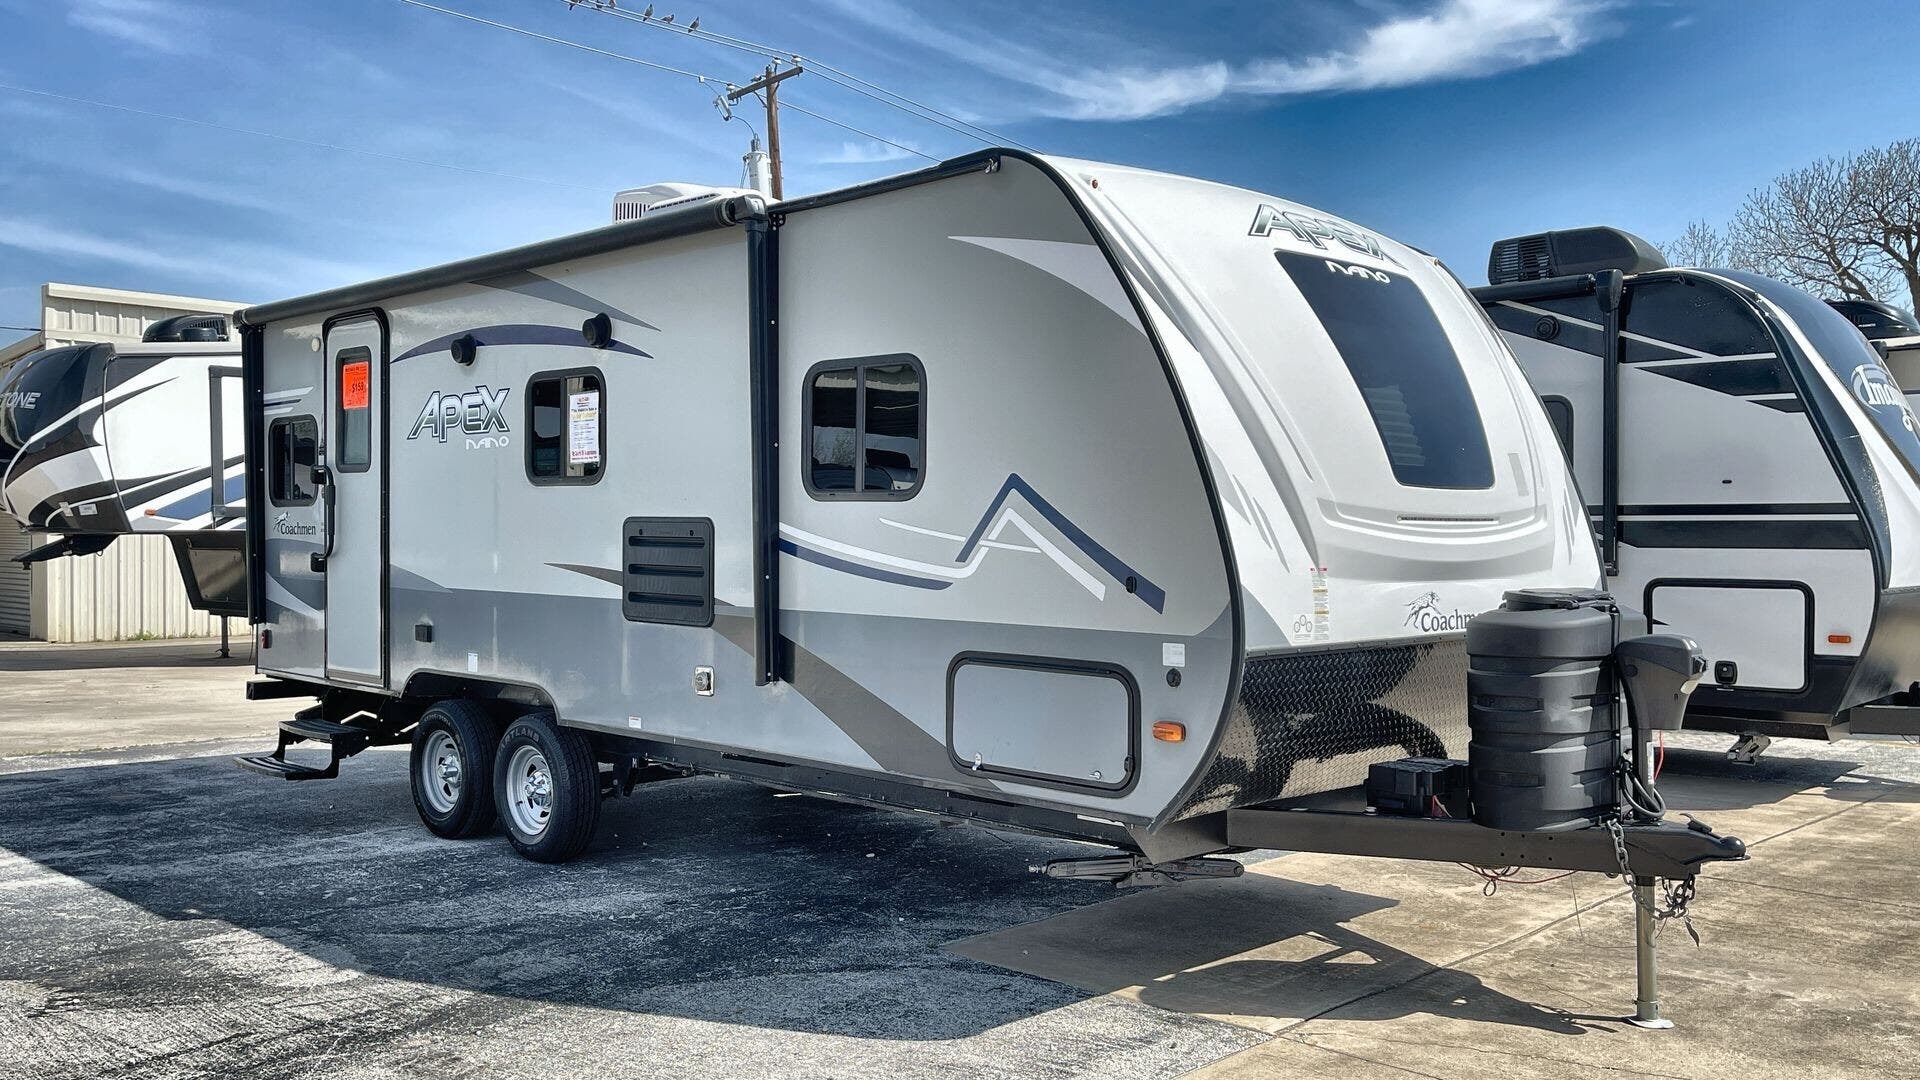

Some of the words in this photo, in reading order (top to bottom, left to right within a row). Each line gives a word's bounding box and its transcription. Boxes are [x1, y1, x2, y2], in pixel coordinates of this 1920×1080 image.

[1248, 203, 1409, 271] APEX
[0, 391, 42, 410] TONE
[407, 385, 510, 443] APEX
[280, 521, 317, 536] Coachmen
[1421, 608, 1476, 633] Coachm
